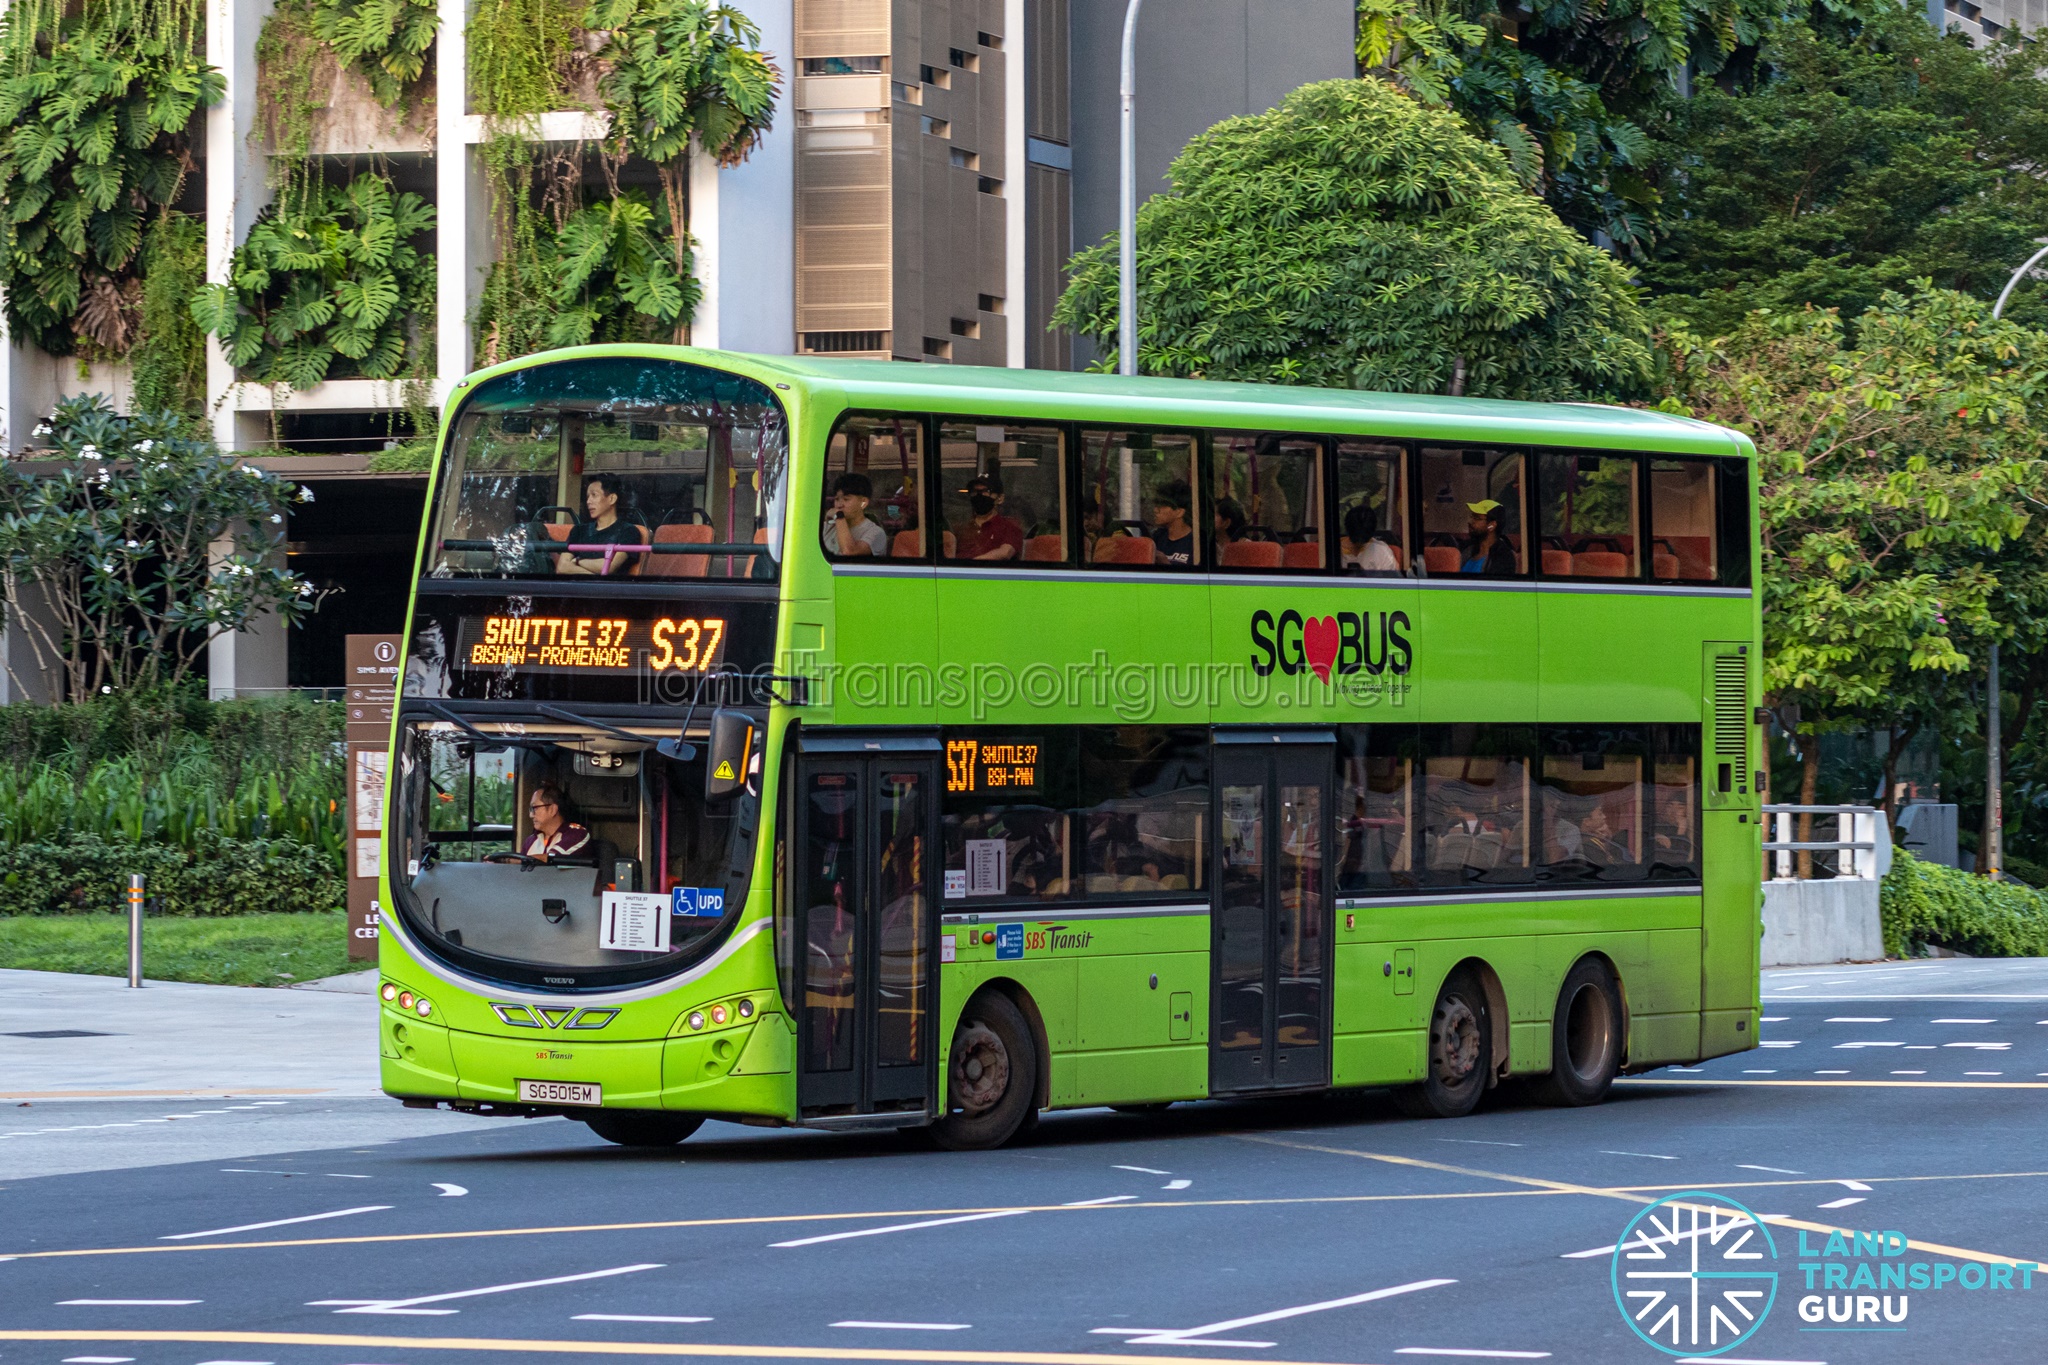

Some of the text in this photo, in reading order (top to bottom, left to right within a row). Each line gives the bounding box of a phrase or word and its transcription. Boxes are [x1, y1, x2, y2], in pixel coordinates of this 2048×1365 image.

[485, 618, 628, 647] SHUTTLE 37
[650, 618, 724, 671] S37
[357, 666, 377, 674] SIMS
[982, 745, 1038, 764] SHUTTLE 37
[947, 740, 977, 791] S37
[699, 895, 723, 910] UPD
[1025, 925, 1094, 953] SBS Transit
[543, 976, 575, 985] VOLVO
[536, 1050, 573, 1060] SBS Transit
[529, 1084, 592, 1102] SG5015M
